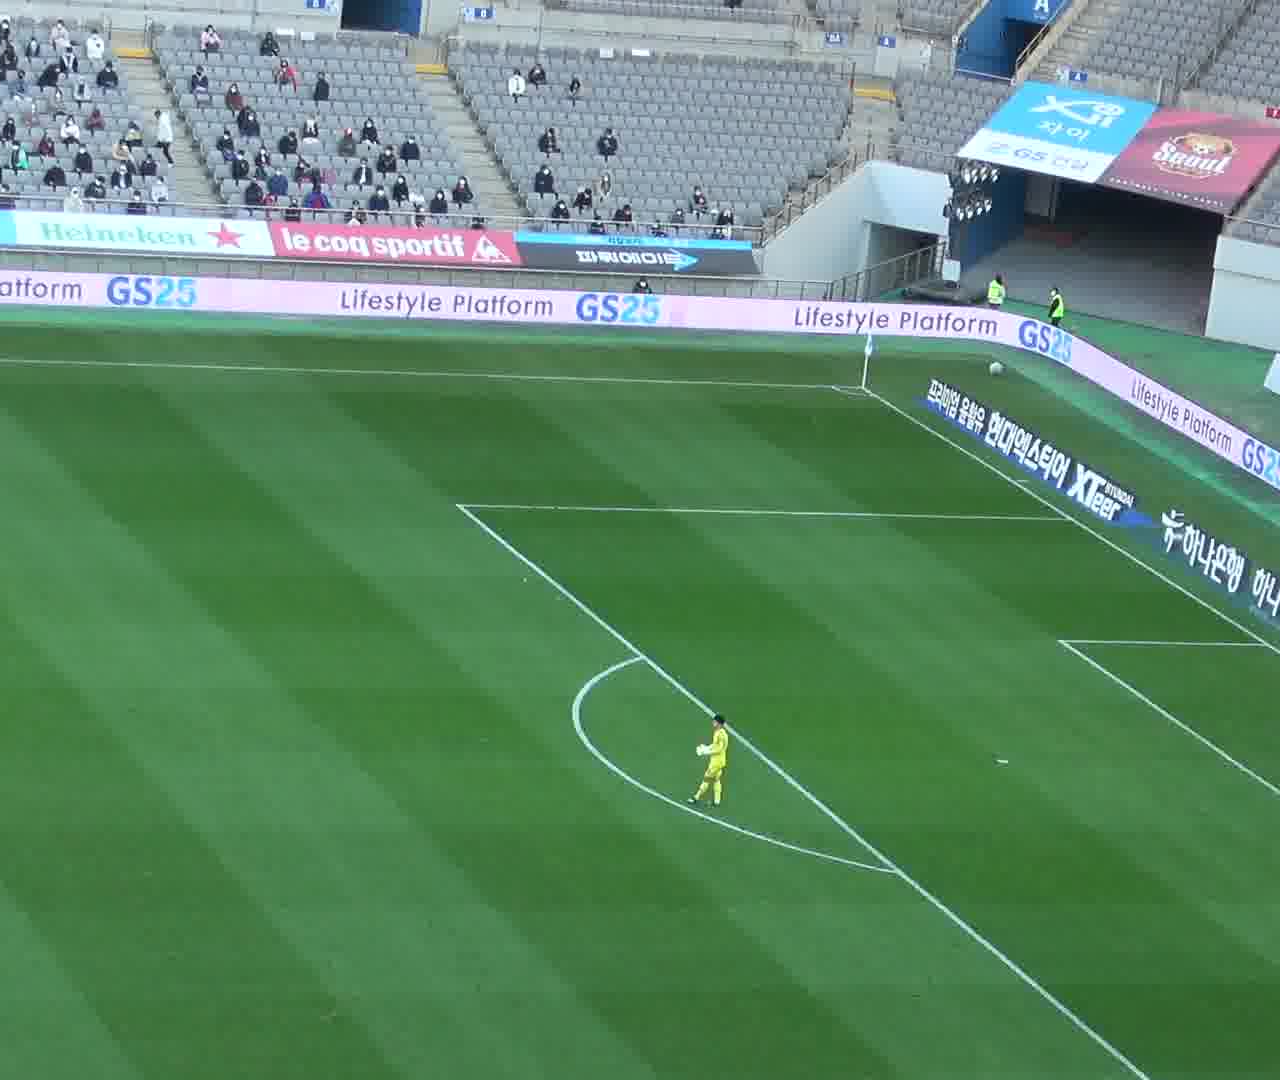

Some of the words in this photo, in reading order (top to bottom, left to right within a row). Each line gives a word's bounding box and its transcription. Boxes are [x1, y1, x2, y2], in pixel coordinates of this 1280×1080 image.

[1151, 141, 1233, 176] Seoul
[40, 221, 197, 246] Heineken
[281, 227, 317, 251] le
[319, 233, 368, 258] coq
[372, 232, 466, 259] sportif
[107, 276, 198, 307] GS25
[340, 288, 443, 318] Lifestyle
[453, 293, 554, 317] Platform
[576, 293, 662, 324] GS25
[793, 306, 889, 334] Lifestyle
[899, 310, 998, 336] Platform
[1019, 319, 1073, 363] GS25
[1131, 377, 1181, 425] Lifestyle
[1182, 403, 1233, 454] Platform
[1066, 463, 1122, 521] XTeer
[1183, 523, 1246, 593] 하나은행
